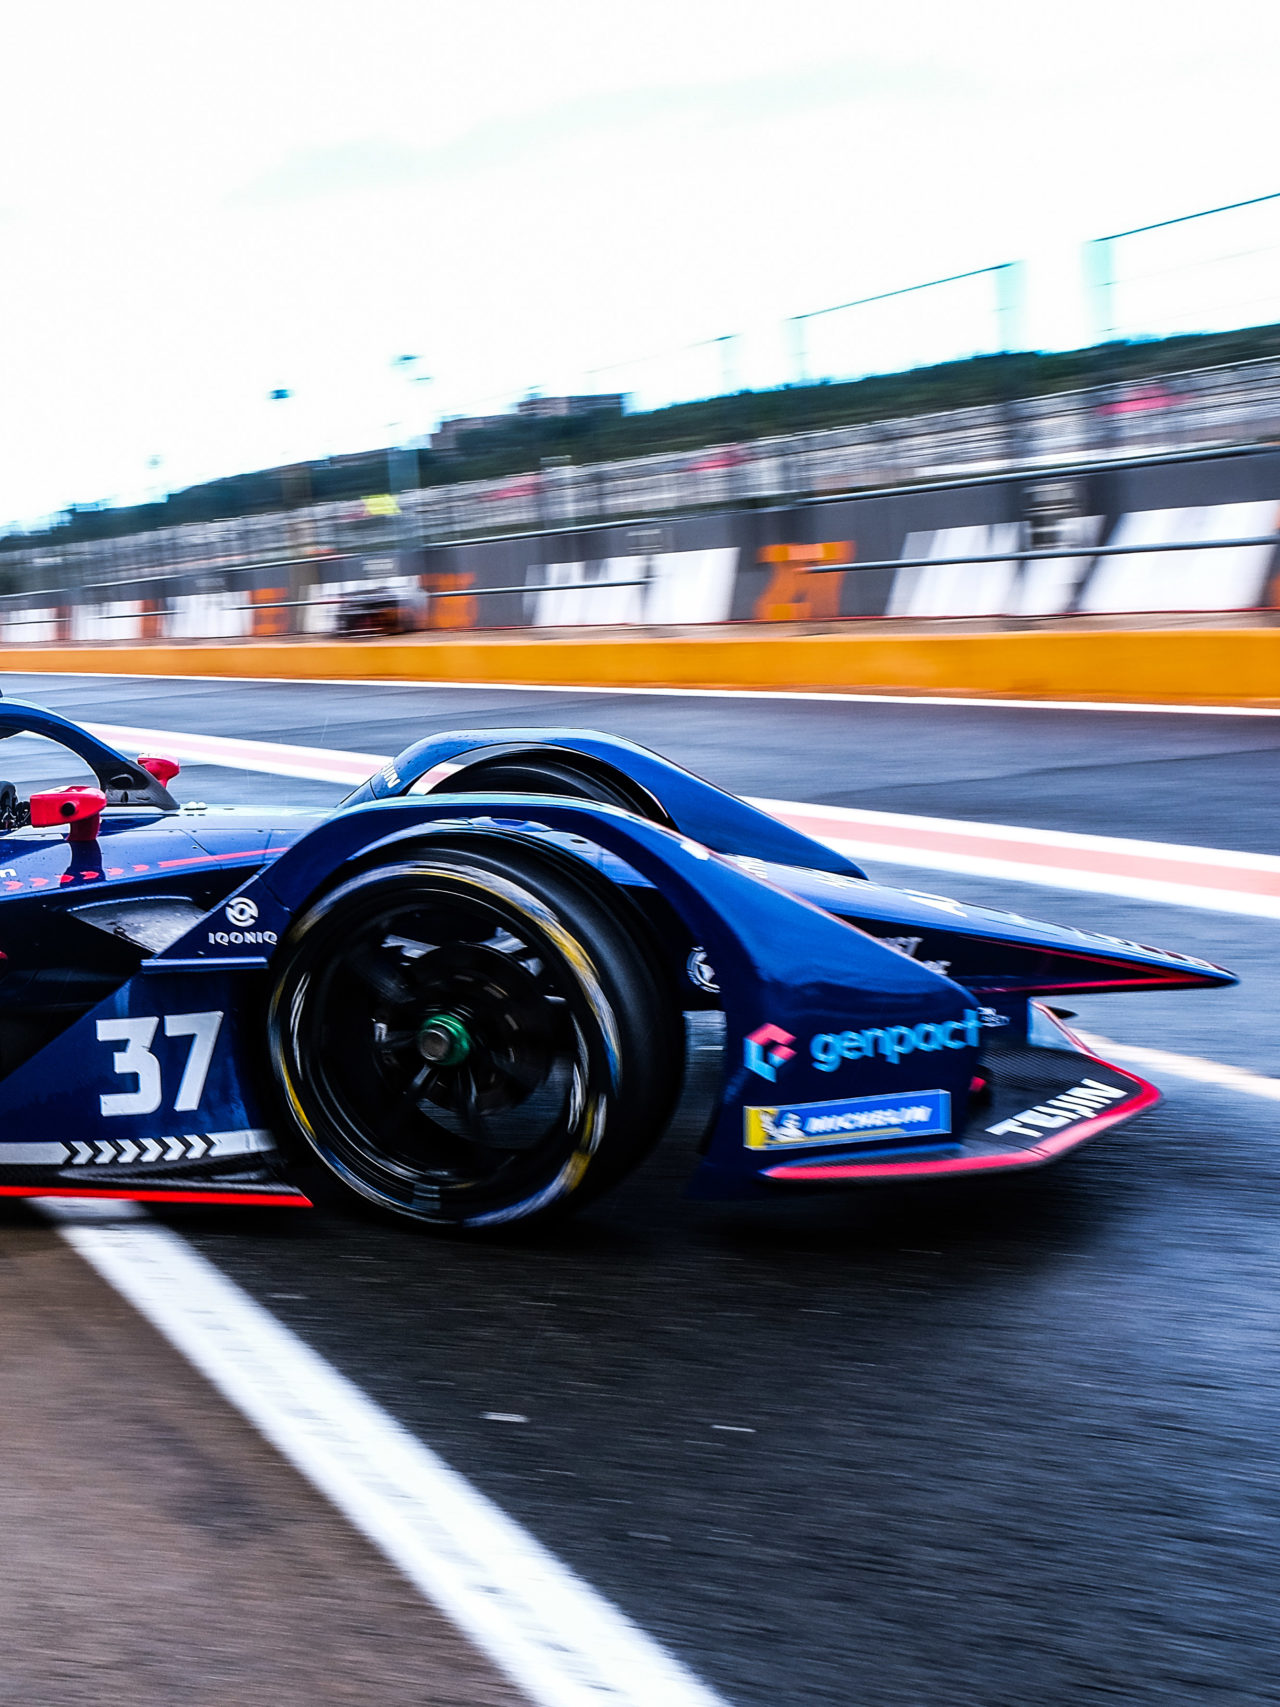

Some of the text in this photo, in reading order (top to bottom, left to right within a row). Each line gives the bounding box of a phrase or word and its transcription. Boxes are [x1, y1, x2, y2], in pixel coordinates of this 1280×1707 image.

[208, 930, 278, 946] IQONIQ
[809, 1008, 980, 1073] genpact
[96, 1010, 225, 1118] 37
[804, 1105, 933, 1133] MICHELIN
